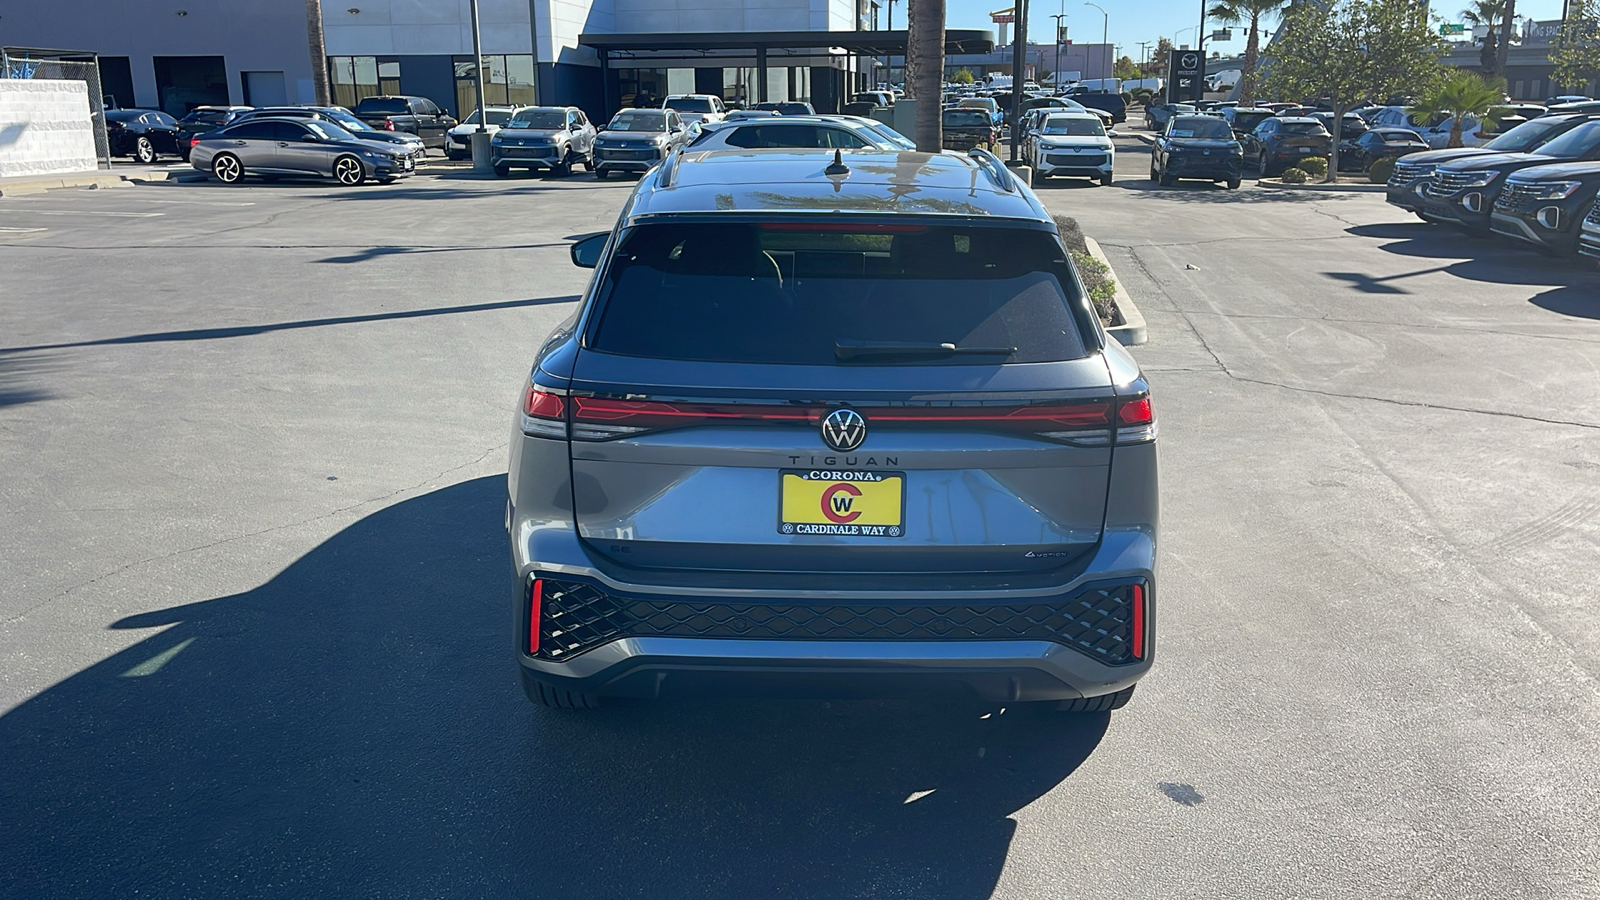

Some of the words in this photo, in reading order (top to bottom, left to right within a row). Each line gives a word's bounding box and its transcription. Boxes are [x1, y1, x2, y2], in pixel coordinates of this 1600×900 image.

[788, 455, 898, 466] TIGUAN
[809, 470, 875, 481] CORONA
[796, 524, 859, 535] CARDINALE
[861, 526, 886, 536] WAY
